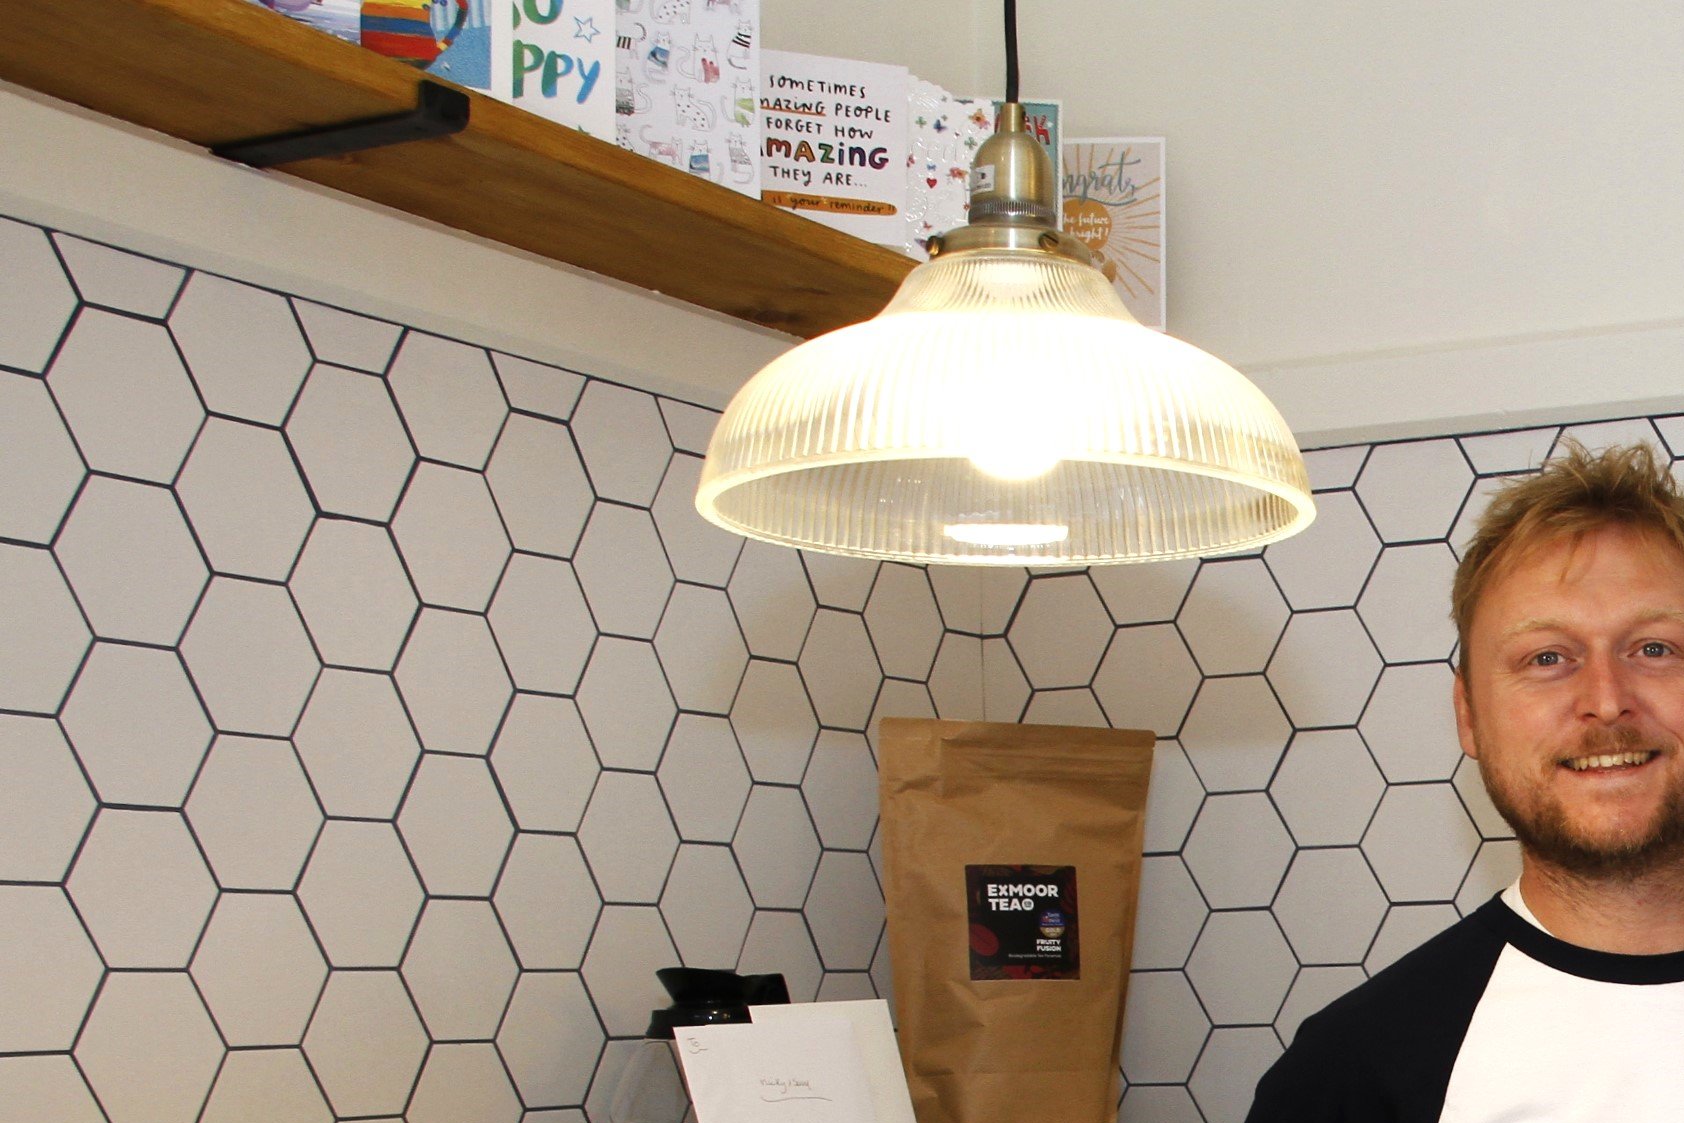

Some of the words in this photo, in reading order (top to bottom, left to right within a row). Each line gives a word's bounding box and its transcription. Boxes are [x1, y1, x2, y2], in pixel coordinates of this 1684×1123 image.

[834, 102, 891, 123] PEOPLE
[766, 117, 823, 135] FORGET
[834, 125, 874, 139] HOW
[769, 165, 812, 187] THEY
[987, 884, 1059, 897] EXMOOR
[988, 898, 1022, 911] TEA
